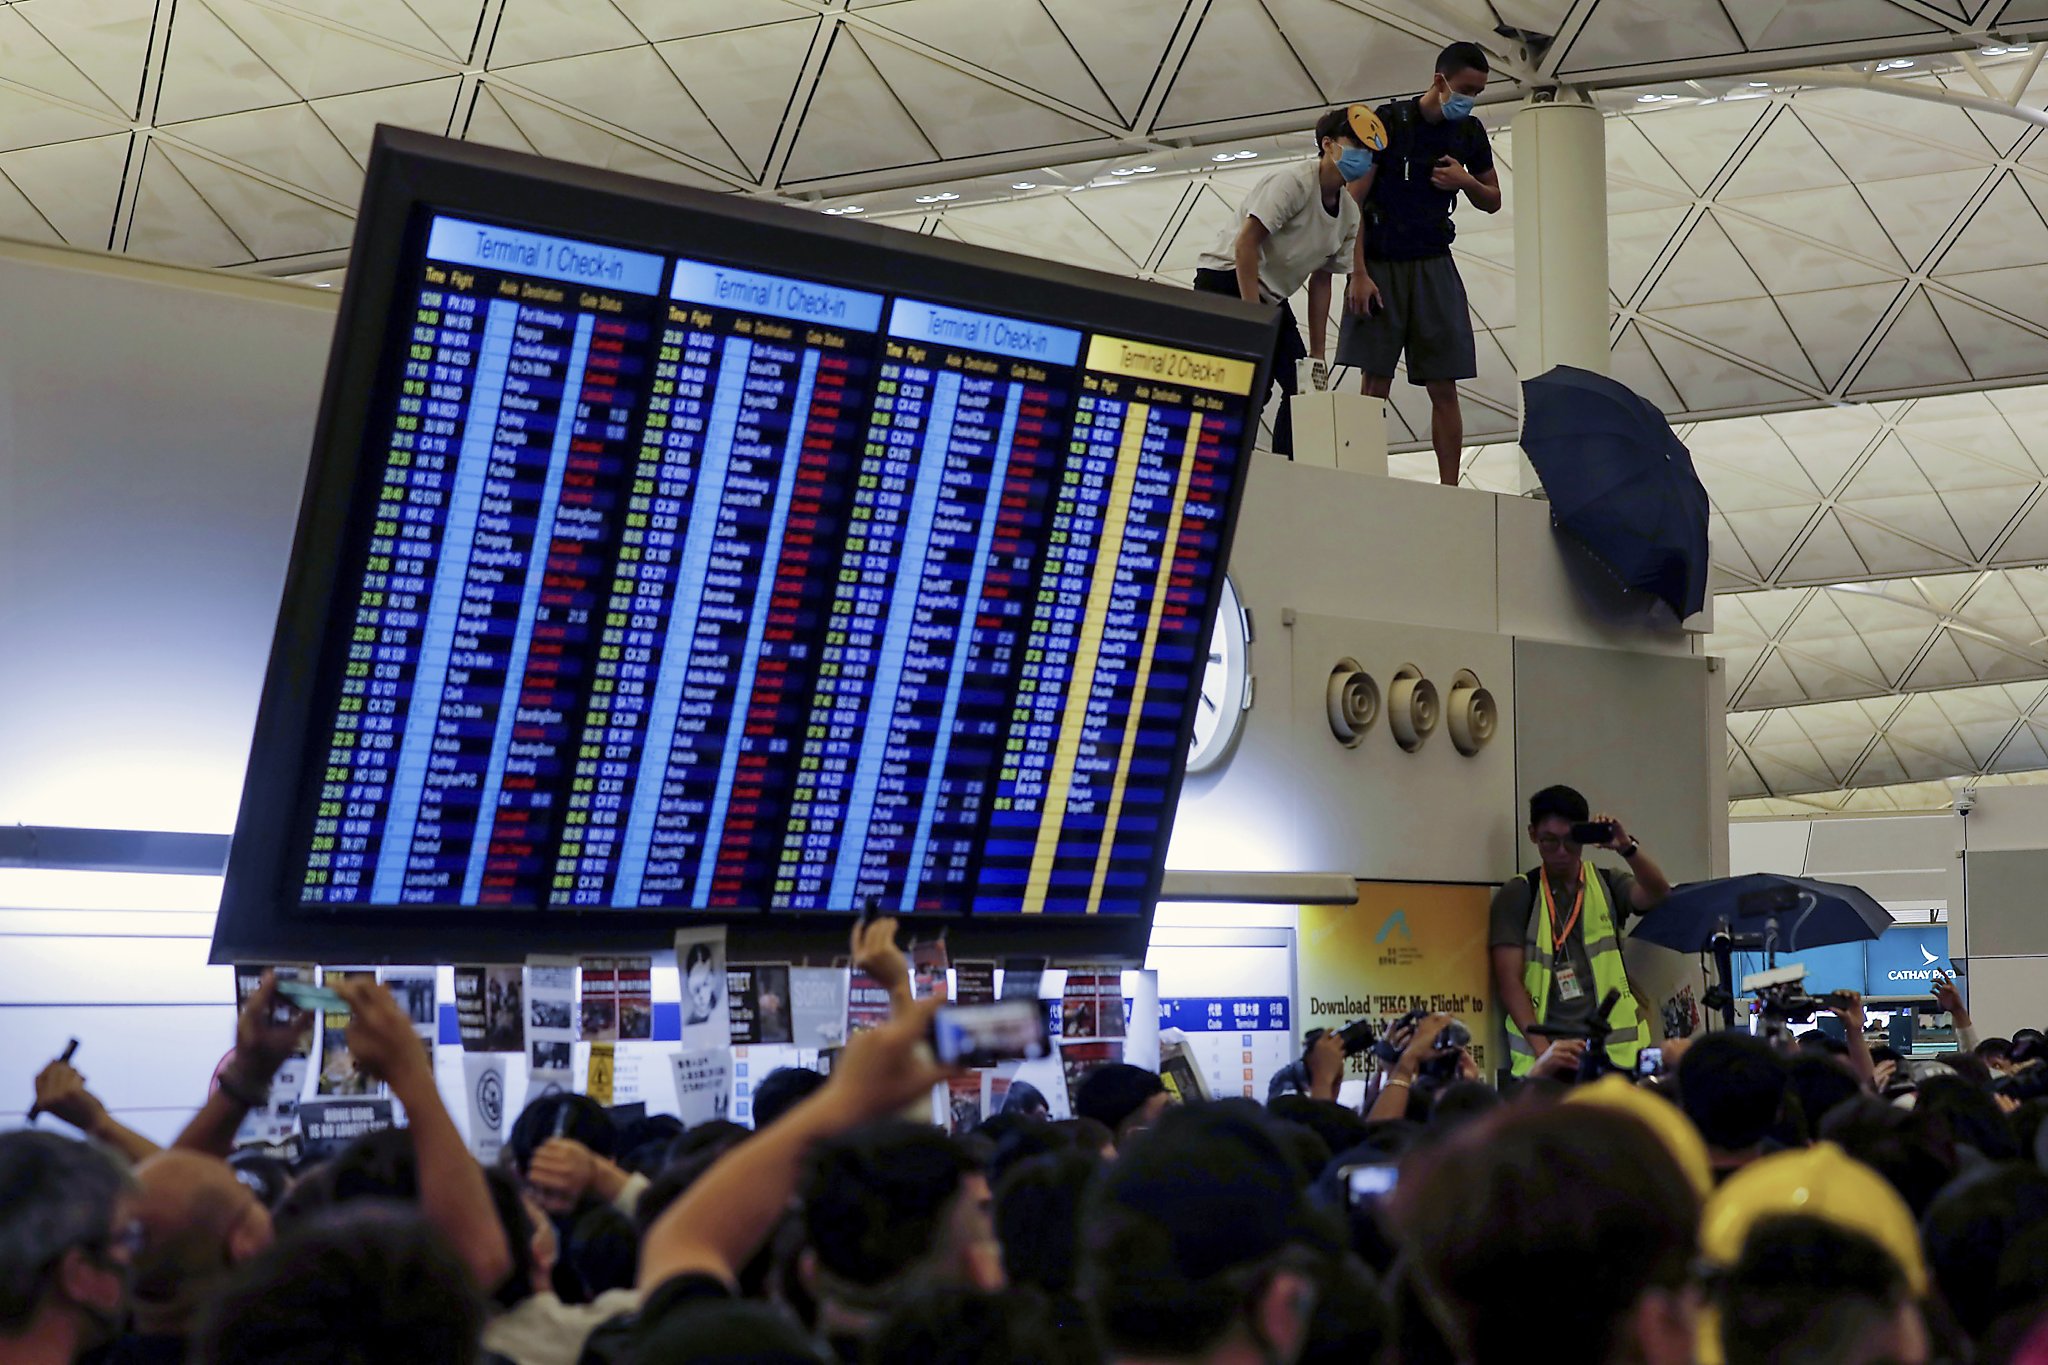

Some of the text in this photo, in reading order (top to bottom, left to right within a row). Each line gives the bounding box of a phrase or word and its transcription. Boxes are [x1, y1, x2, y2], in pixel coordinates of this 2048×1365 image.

[474, 233, 624, 280] Terminal 1 Check-in
[713, 273, 846, 318] Terminal 1 Check-in
[927, 311, 1048, 352] Terminal 1 Check-in
[1119, 345, 1225, 383] Terminal 2 Check-in
[1888, 969, 1930, 980] CATHAY
[1311, 995, 1370, 1015] Download
[1374, 995, 1407, 1013] "HKG
[1410, 995, 1428, 1012] My
[1472, 997, 1483, 1012] to
[1207, 1019, 1222, 1030] Code
[1235, 1018, 1258, 1029] Terminal
